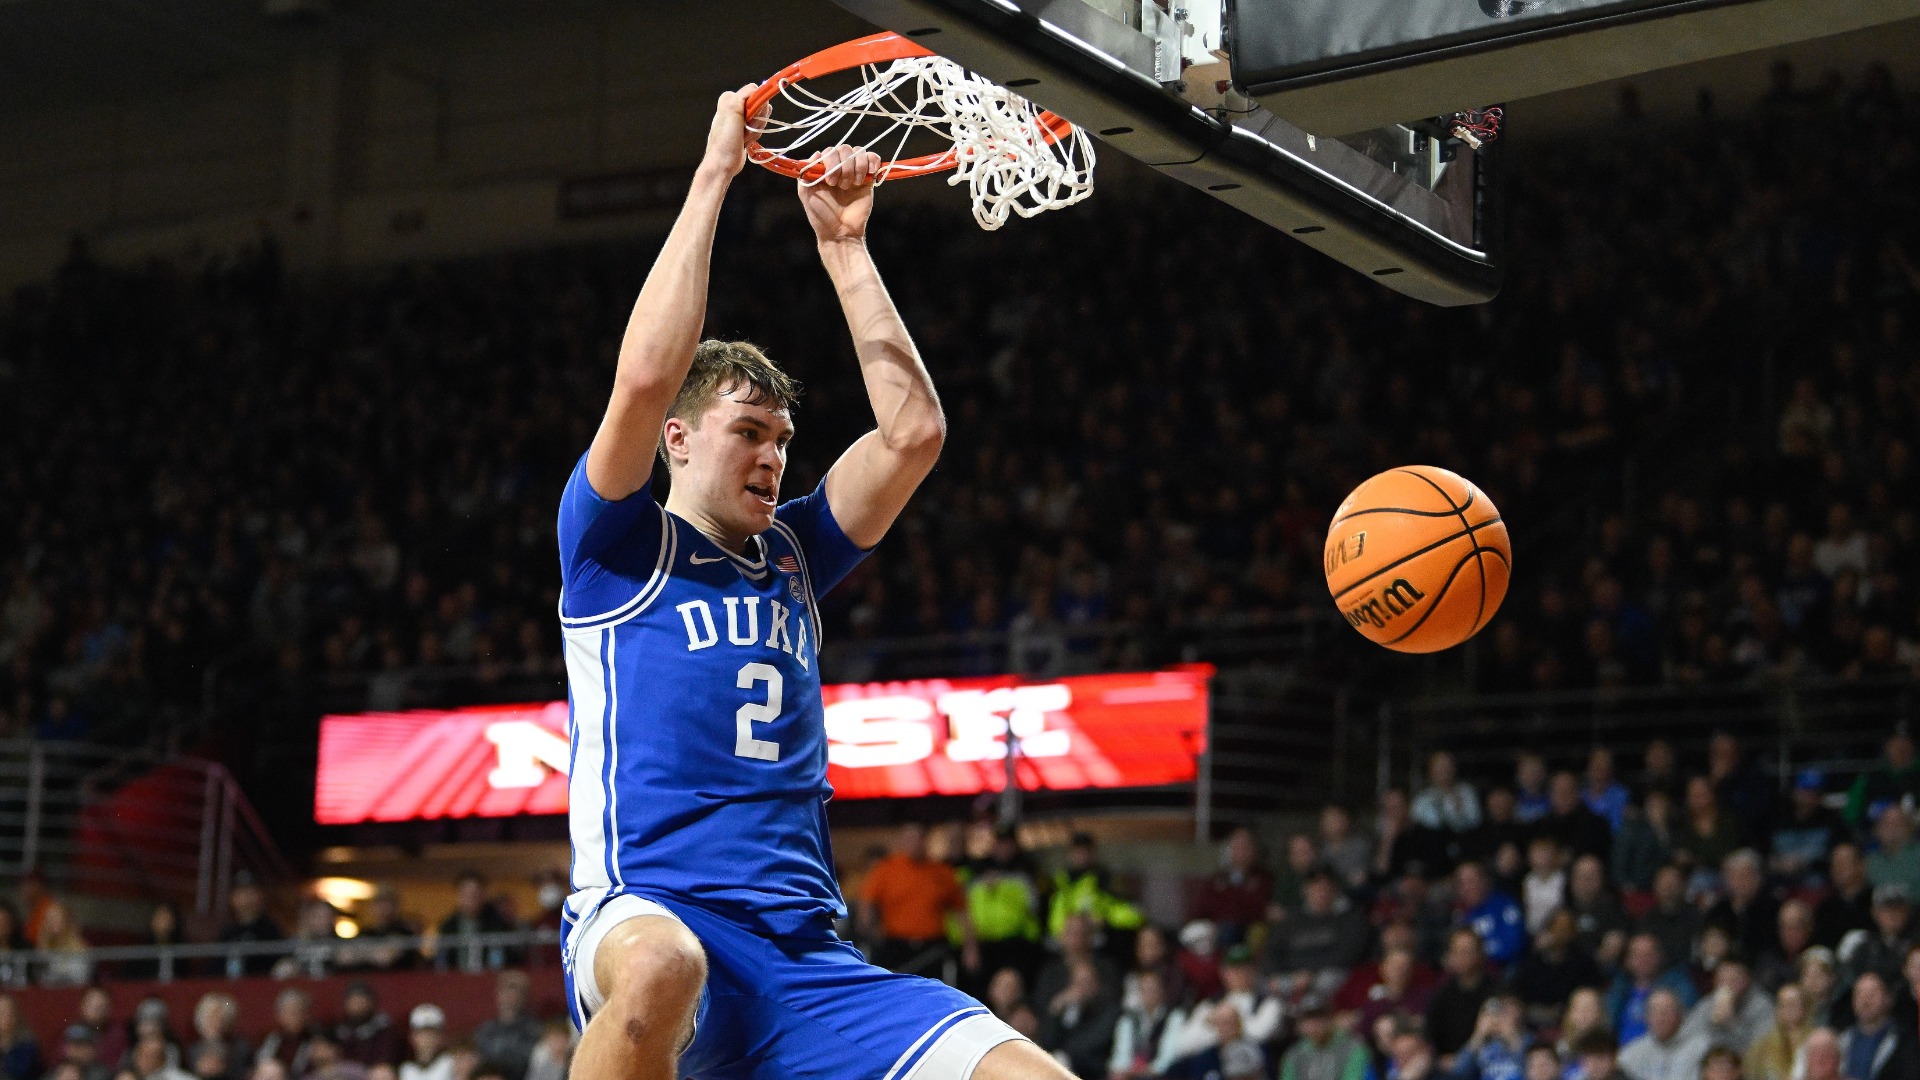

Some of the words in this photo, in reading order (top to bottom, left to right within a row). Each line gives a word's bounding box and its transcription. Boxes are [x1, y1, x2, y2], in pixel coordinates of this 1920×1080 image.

[675, 596, 810, 672] DUKE
[1342, 578, 1426, 629] Wilso
[734, 662, 783, 762] 2
